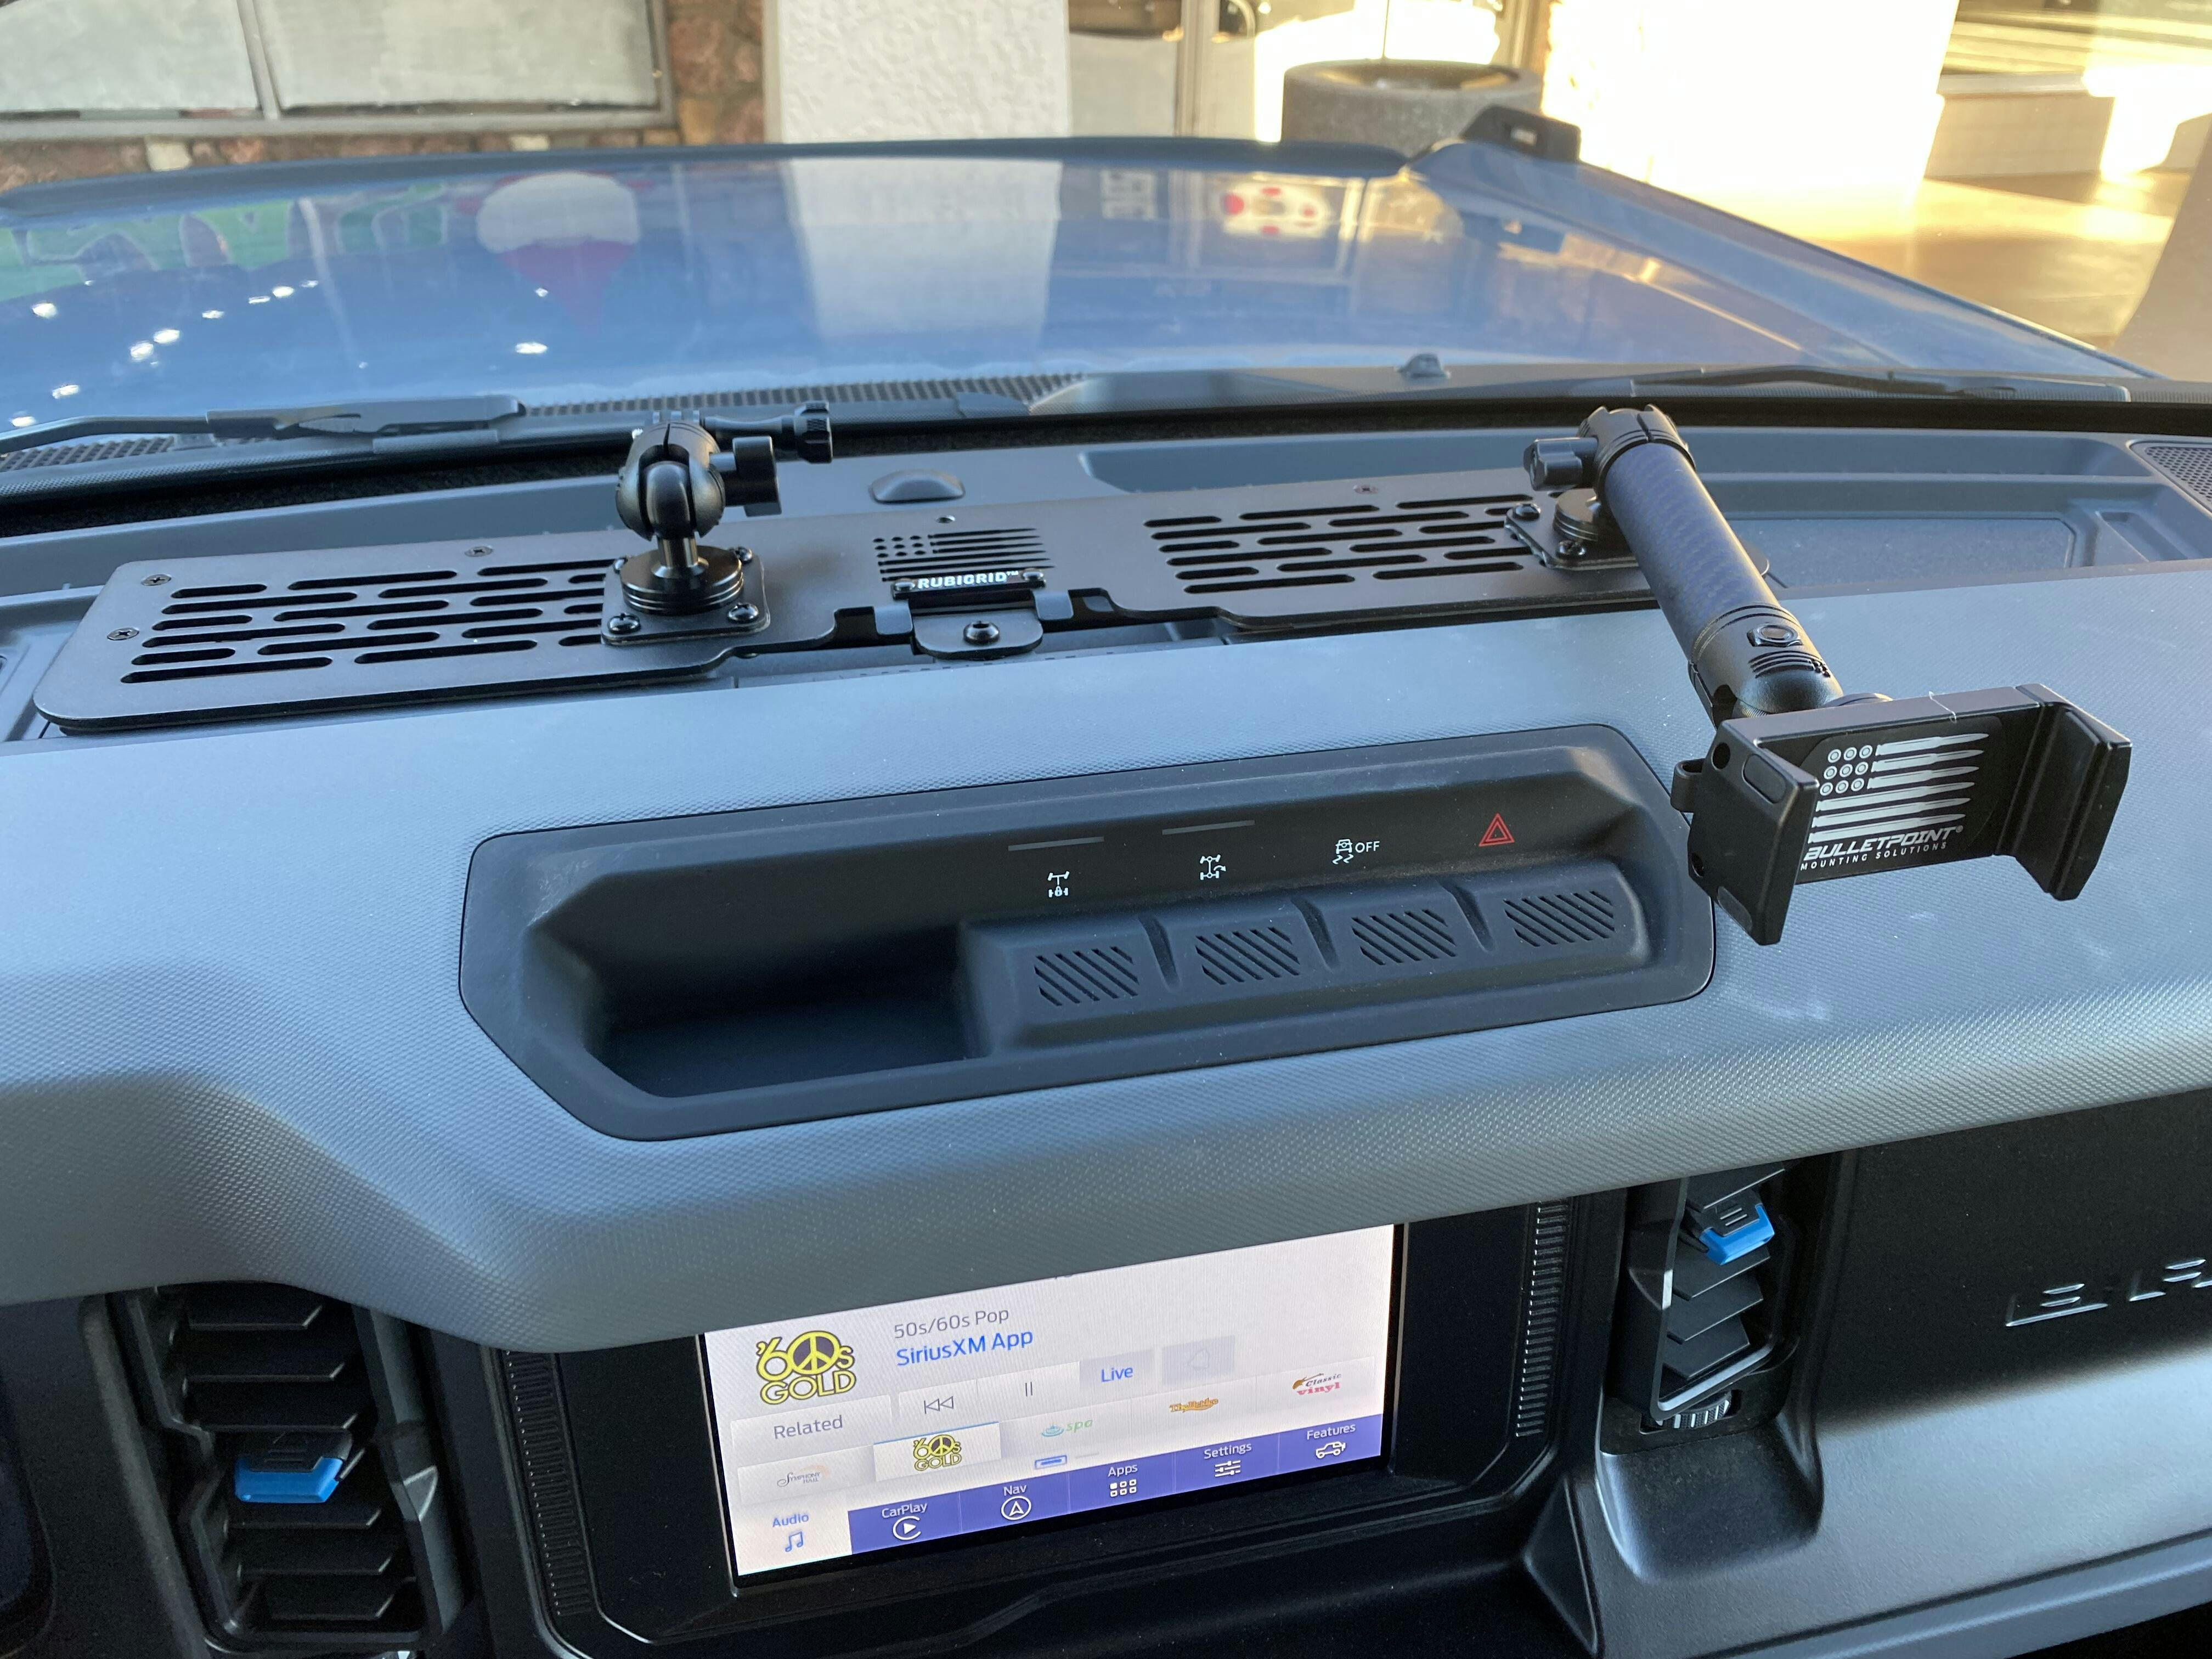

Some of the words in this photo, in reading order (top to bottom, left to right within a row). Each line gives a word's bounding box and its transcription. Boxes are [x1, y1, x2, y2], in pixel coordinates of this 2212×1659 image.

[1355, 841, 1380, 853] OFF
[1800, 854, 1868, 871] MOUNTING
[1875, 842, 1946, 860] SOLUTIONS
[894, 1314, 970, 1339] 50s/60s
[975, 1308, 1009, 1325] Pop
[896, 1335, 986, 1367] SiriusXM
[992, 1330, 1034, 1351] App
[1101, 1365, 1134, 1383] Live
[1306, 1374, 1342, 1386] Classic
[760, 1370, 856, 1405] GOLD
[1297, 1382, 1340, 1395] vinyl
[774, 1414, 843, 1440] Related
[1065, 1418, 1093, 1432] spa
[1306, 1423, 1356, 1440] Features
[1204, 1442, 1252, 1460] Settings
[914, 1453, 962, 1471] GOLD
[1108, 1463, 1138, 1479] Apps
[1003, 1484, 1027, 1497] Nav
[881, 1502, 928, 1519] CarPlay
[772, 1513, 810, 1528] Audio
